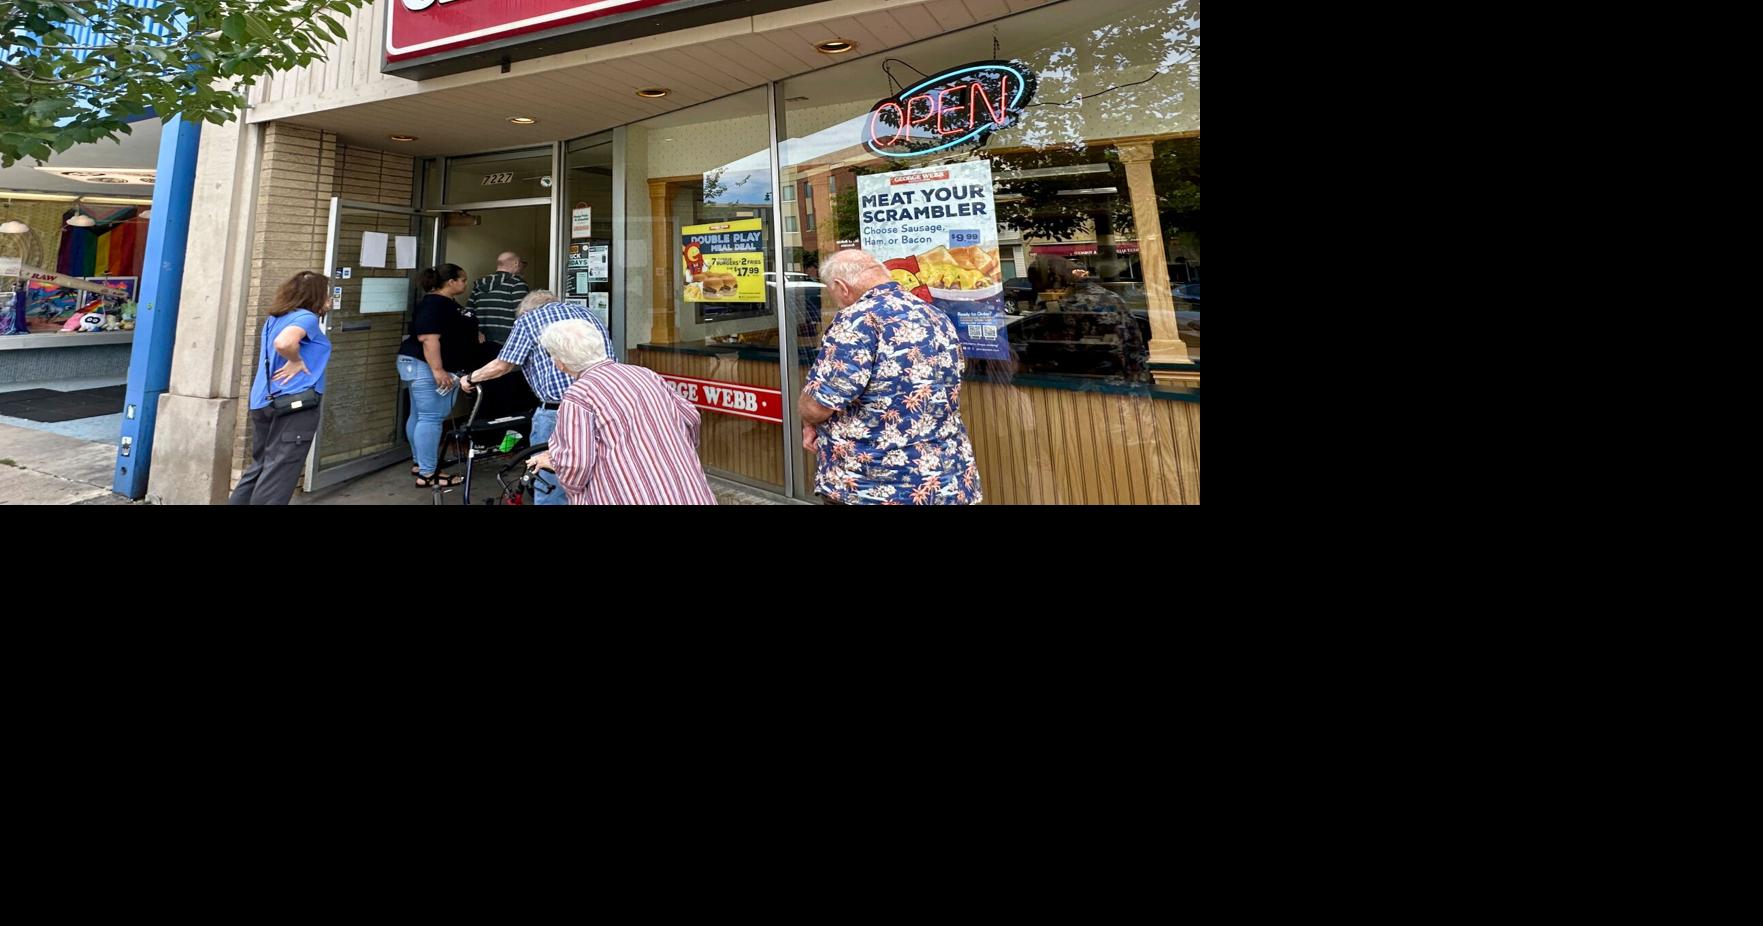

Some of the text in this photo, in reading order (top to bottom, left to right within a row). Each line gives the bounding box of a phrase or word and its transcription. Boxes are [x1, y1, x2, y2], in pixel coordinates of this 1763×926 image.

[870, 75, 1008, 146] OPEN
[482, 172, 513, 185] 7227
[862, 184, 985, 208] MEAT YOUR
[863, 202, 987, 223] SCRAMBLER
[863, 224, 946, 235] Choose Sausage,
[691, 232, 760, 244] DOUBLE PLAY
[865, 237, 887, 246] Ham,
[902, 235, 932, 244] Bacon
[951, 234, 978, 242] $9.99
[711, 244, 732, 252] MEAL
[31, 273, 58, 281] RAW
[734, 267, 759, 277] $17.99
[703, 386, 758, 411] WEBB
